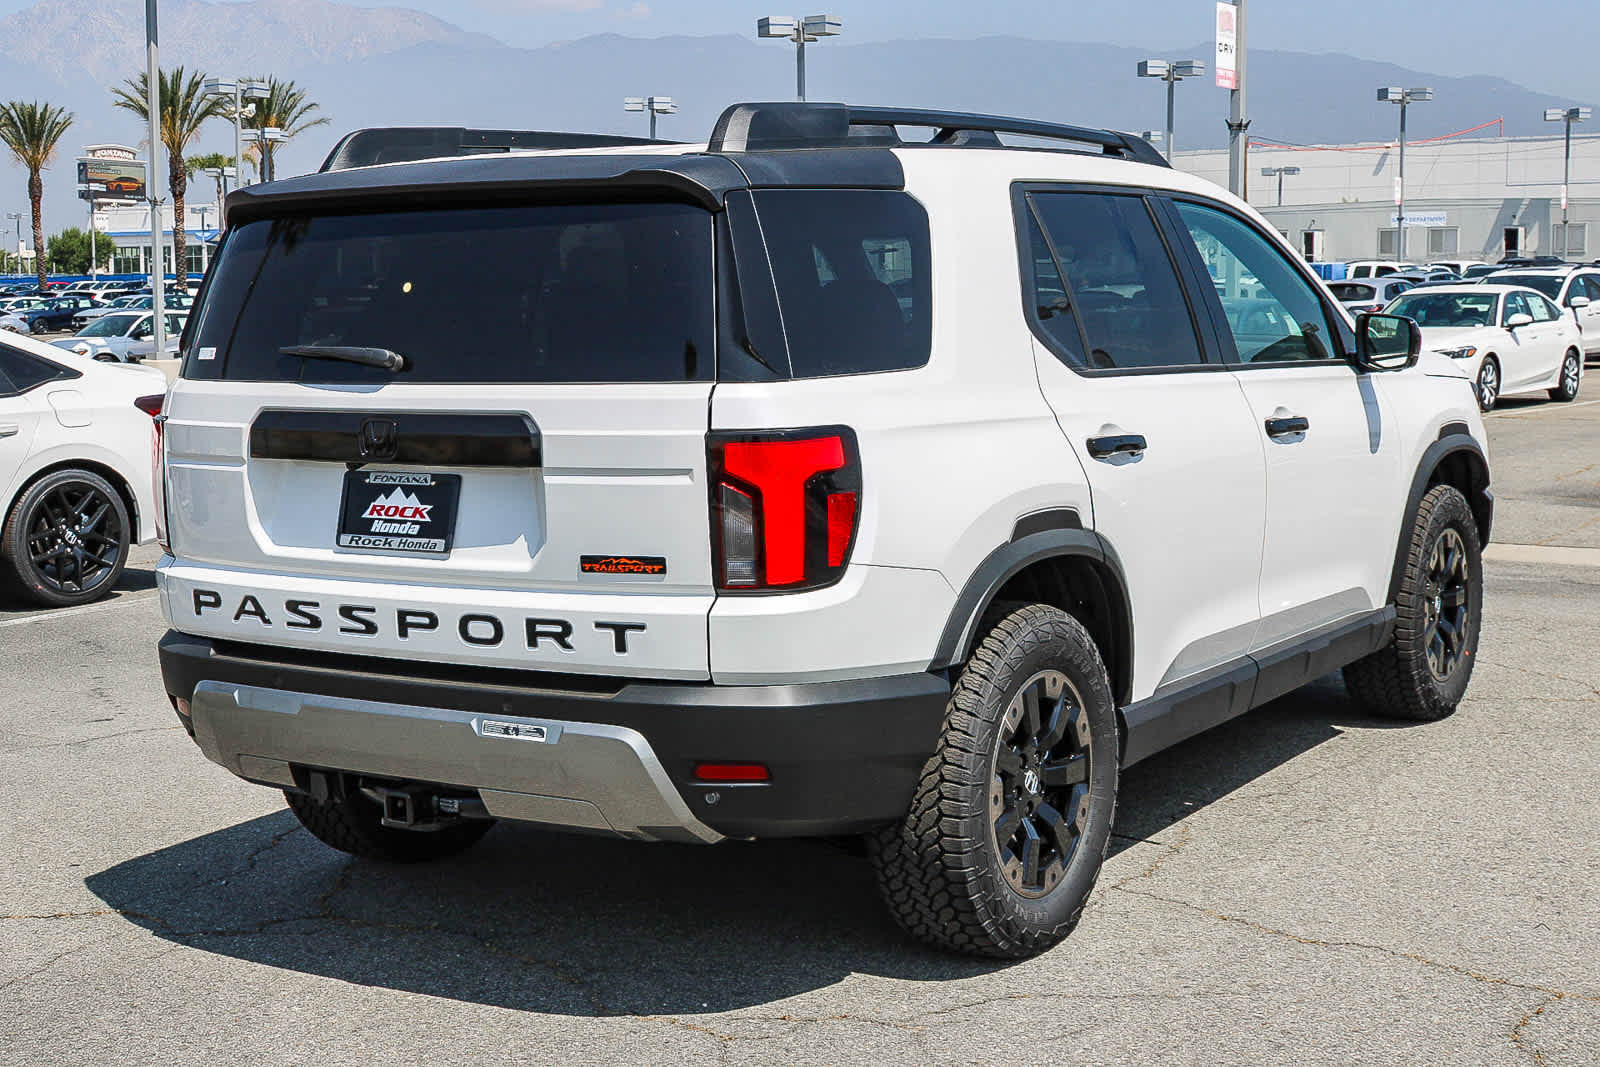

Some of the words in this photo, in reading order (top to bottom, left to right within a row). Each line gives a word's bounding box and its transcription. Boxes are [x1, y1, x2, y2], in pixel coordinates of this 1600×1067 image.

[372, 474, 429, 484] FONTANA
[368, 504, 429, 519] ROCK
[370, 519, 420, 535] Honda
[348, 535, 394, 548] Rock
[397, 538, 438, 550] Honda
[582, 563, 664, 574] TRAILSPORT
[193, 589, 646, 653] PASSPORT
